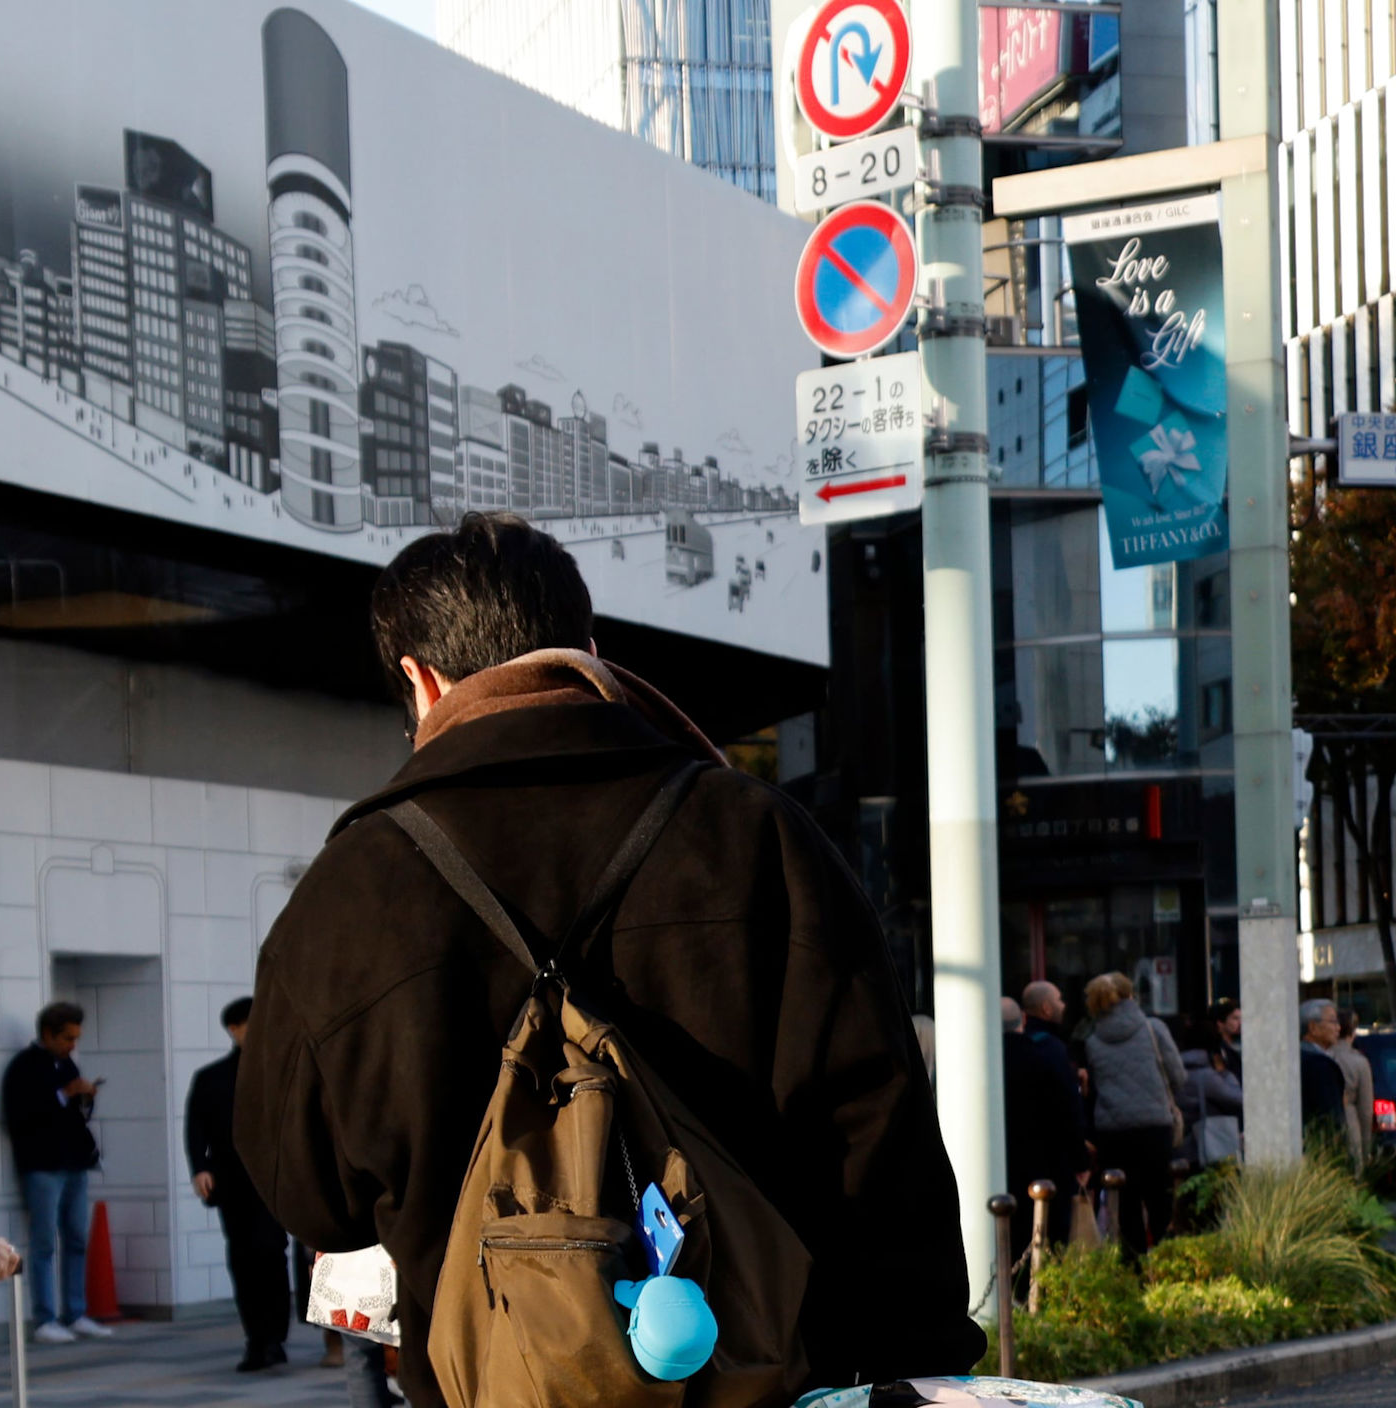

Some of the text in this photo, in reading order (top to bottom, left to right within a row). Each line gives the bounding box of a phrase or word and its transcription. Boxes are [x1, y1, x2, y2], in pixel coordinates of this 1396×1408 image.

[1165, 204, 1190, 218] GILC
[1095, 237, 1170, 286] Love
[1127, 286, 1175, 318] is a
[1140, 308, 1207, 371] Gift
[805, 404, 915, 445] タクシーの客待ち
[806, 446, 857, 476] を除く
